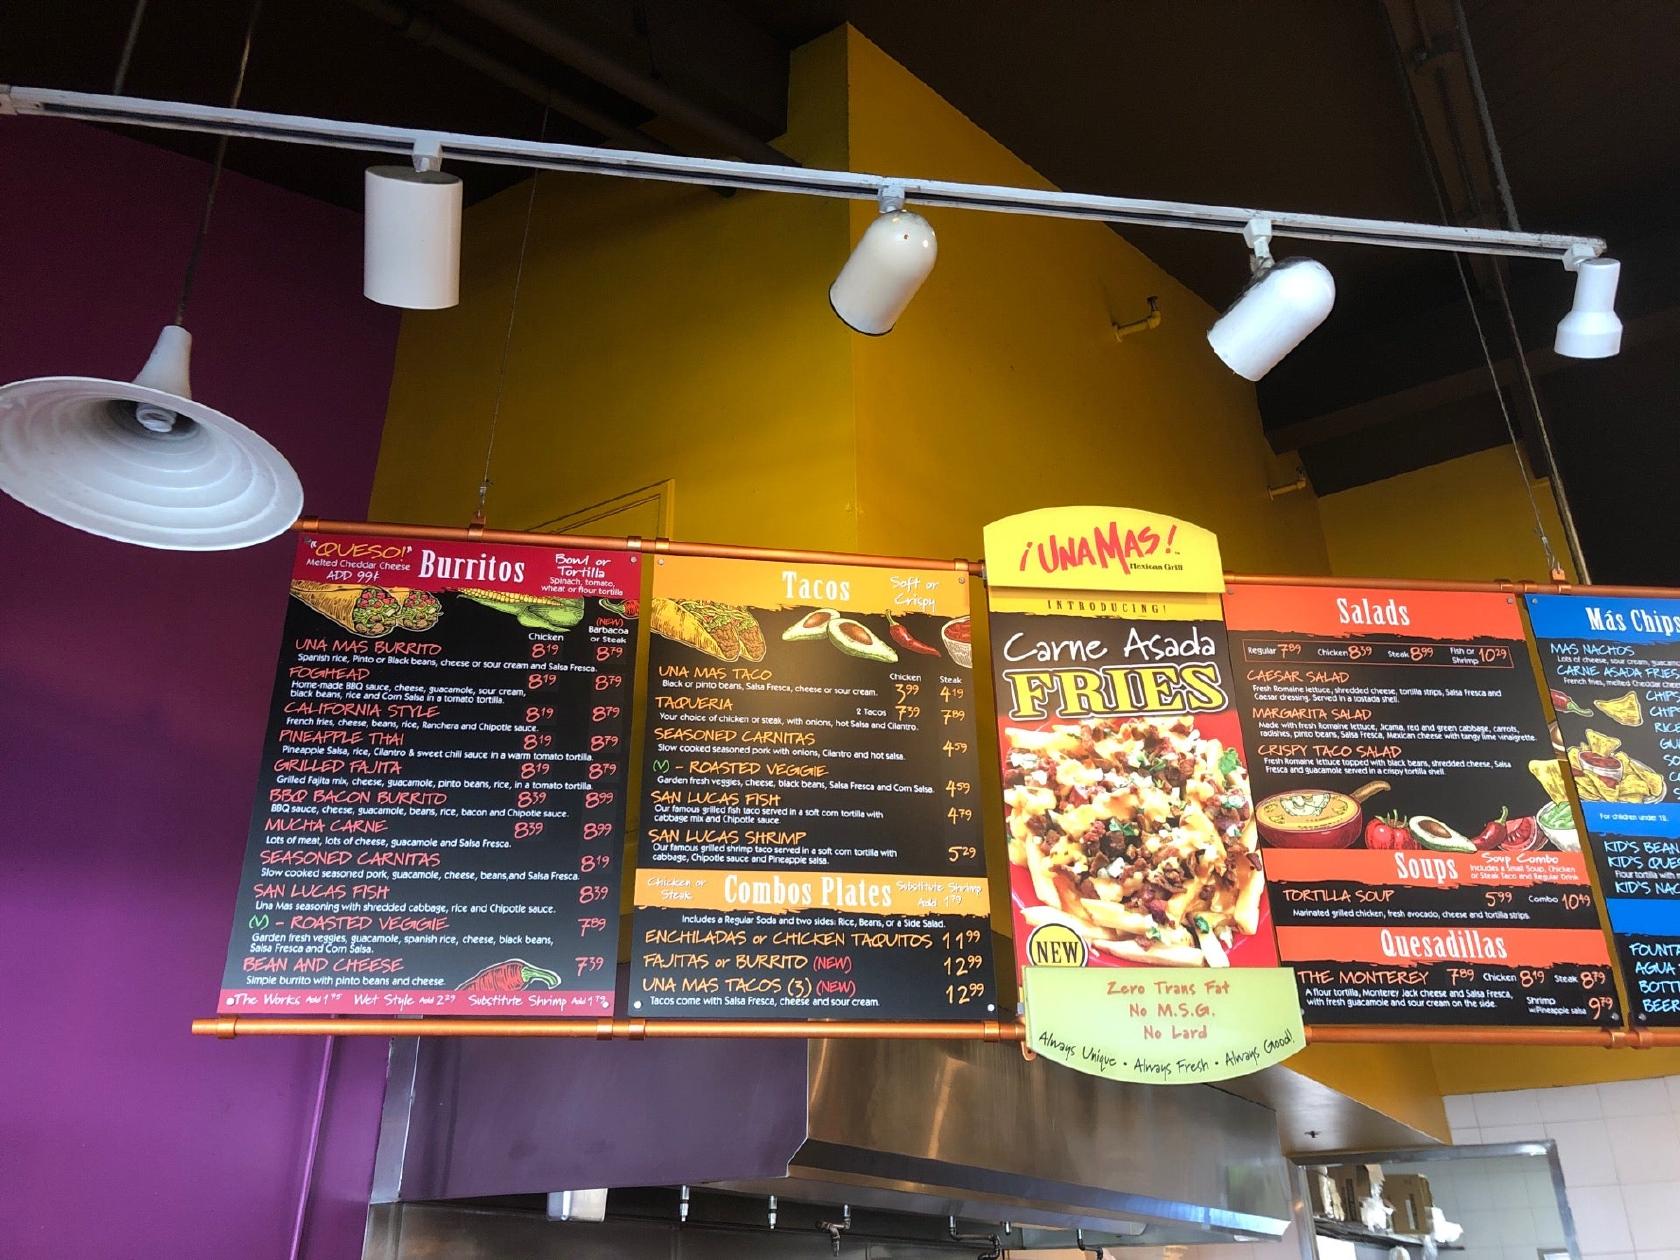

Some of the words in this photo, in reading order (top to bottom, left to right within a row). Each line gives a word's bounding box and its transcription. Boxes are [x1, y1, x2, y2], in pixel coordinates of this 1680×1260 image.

[306, 559, 338, 568] Melted
[340, 560, 377, 570] Cheddar
[380, 562, 411, 571] Cheese
[418, 550, 525, 582] Burritos
[555, 553, 595, 566] Bowl
[598, 557, 610, 567] or
[326, 570, 352, 580] ADD
[558, 565, 606, 578] Tortilla
[541, 584, 563, 592] wheat
[578, 586, 596, 594] flour
[550, 576, 583, 586] Spinach,
[585, 579, 616, 588] tomato,
[782, 571, 850, 601] Tacos
[890, 576, 921, 589] Soft
[925, 581, 939, 590] or
[894, 594, 936, 609] Crispy
[1047, 600, 1166, 613] INTRODUCING!
[1336, 598, 1410, 626] Salads
[1585, 607, 1627, 632] Más
[529, 632, 564, 642] Chicken
[589, 626, 629, 635] Barbacoa
[602, 635, 626, 644] Steak
[1003, 632, 1108, 662] Carne
[1124, 626, 1216, 661] Asada
[295, 639, 327, 651] UNA
[333, 641, 368, 653] MAS
[374, 642, 442, 655] BURRITO
[1248, 647, 1276, 656] Regular
[1317, 648, 1348, 657] Chicken
[1551, 644, 1578, 654] MAS
[1584, 644, 1634, 656] NACHOS
[1452, 656, 1479, 665] Shrimp
[289, 667, 370, 679] FOGHEAD
[658, 666, 689, 677] UNA
[694, 668, 727, 679] MAS
[733, 668, 772, 680] TACO
[1247, 671, 1303, 682] CAESAR
[1309, 672, 1349, 683] SALAD
[1557, 665, 1600, 676] CARNE
[1604, 667, 1642, 677] ASADA
[889, 673, 921, 682] Chicken
[940, 676, 962, 684] Steak
[1002, 662, 1228, 721] FRIES
[284, 702, 380, 718] CALIFORNIA
[387, 705, 440, 718] STYLE
[656, 696, 734, 711] TAQUERIA
[1252, 708, 1328, 720] MARGARITA
[1331, 709, 1372, 720] SALAD
[286, 717, 310, 726] French
[313, 718, 336, 727] fries,
[338, 720, 368, 728] cheese,
[371, 721, 399, 729] beans,
[402, 722, 419, 730] rice,
[422, 721, 460, 731] Ranchera
[462, 723, 476, 731] and
[479, 723, 511, 733] Chipotle
[514, 725, 538, 733] sauce.
[279, 730, 363, 744] PINEAPPLE
[368, 732, 405, 746] THAI
[654, 728, 737, 741] SEASONED
[742, 731, 815, 745] CARNITAS
[1258, 745, 1307, 757] CRISPY
[1313, 746, 1352, 758] TACO
[1357, 746, 1401, 758] SALAD
[274, 759, 345, 772] GRILLED
[349, 761, 402, 774] FAJITA
[689, 761, 761, 775] ROASTED
[767, 764, 829, 776] VEGGIE
[269, 789, 307, 803] BBQ
[313, 790, 370, 805] BACON
[377, 792, 448, 806] BURRITO
[651, 792, 681, 803] SAN
[687, 792, 739, 805] LUCAS
[746, 794, 781, 806] FISH
[265, 818, 325, 833] MUCHA
[330, 819, 388, 833] CARNE
[648, 829, 680, 842] SAN
[686, 831, 739, 843] LUCAS
[745, 832, 807, 845] SHRIMP
[1604, 841, 1639, 854] KID'S
[259, 851, 352, 866] SEASONED
[357, 853, 440, 867] CARNITAS
[1481, 852, 1511, 865] Soup
[1515, 853, 1559, 864] Combo
[1607, 856, 1643, 869] KID'S
[1395, 852, 1458, 883] Soups
[254, 885, 286, 898] SAN
[291, 886, 347, 899] LUCAS
[353, 886, 390, 899] FISH
[724, 875, 815, 905] Combos
[821, 876, 892, 907] Plates
[1615, 881, 1650, 894] KID'S
[1283, 890, 1351, 902] TORTILLA
[1356, 890, 1395, 902] SOUP
[1528, 895, 1558, 904] Combo
[291, 916, 371, 930] ROASTED
[379, 917, 450, 930] VEGGIE
[644, 930, 746, 945] ENCHILADAS
[752, 934, 767, 944] or
[772, 932, 845, 947] CHICKEN
[851, 933, 933, 948] TAQUITOS
[1381, 930, 1507, 961] Quesadillas
[1037, 940, 1079, 964] NEW
[243, 958, 289, 972] BEAN
[293, 958, 328, 972] AND
[333, 959, 404, 973] CHEESE
[643, 955, 708, 968] FAJITAS
[715, 958, 730, 968] or
[736, 955, 808, 969] BURRITO
[813, 956, 852, 973] (NEW)
[1635, 961, 1676, 974] AGUA
[1298, 971, 1334, 984] THE
[1339, 971, 1430, 986] MONTEREY
[1483, 973, 1517, 982] Chicken
[1554, 974, 1578, 983] Steak
[643, 979, 677, 992] UNA
[682, 979, 719, 992] MAS
[725, 978, 781, 993] TACOS
[787, 979, 812, 997] (3)
[816, 980, 857, 997] (NEW)
[1107, 981, 1145, 994] Zero
[1154, 982, 1196, 994] Trans
[1204, 981, 1229, 994] Fat
[1527, 996, 1556, 1005] Shrimp
[1129, 1004, 1148, 1016] No
[1158, 1004, 1215, 1017] M.S.G.
[1144, 1027, 1162, 1040] No
[1172, 1026, 1207, 1039] Lard
[1038, 1031, 1075, 1056] Always
[1082, 1046, 1117, 1071] Unique
[1134, 1059, 1171, 1081] Always
[1177, 1059, 1209, 1073] Fresh
[1225, 1048, 1260, 1066] Always
[1263, 1029, 1295, 1053] Good!
